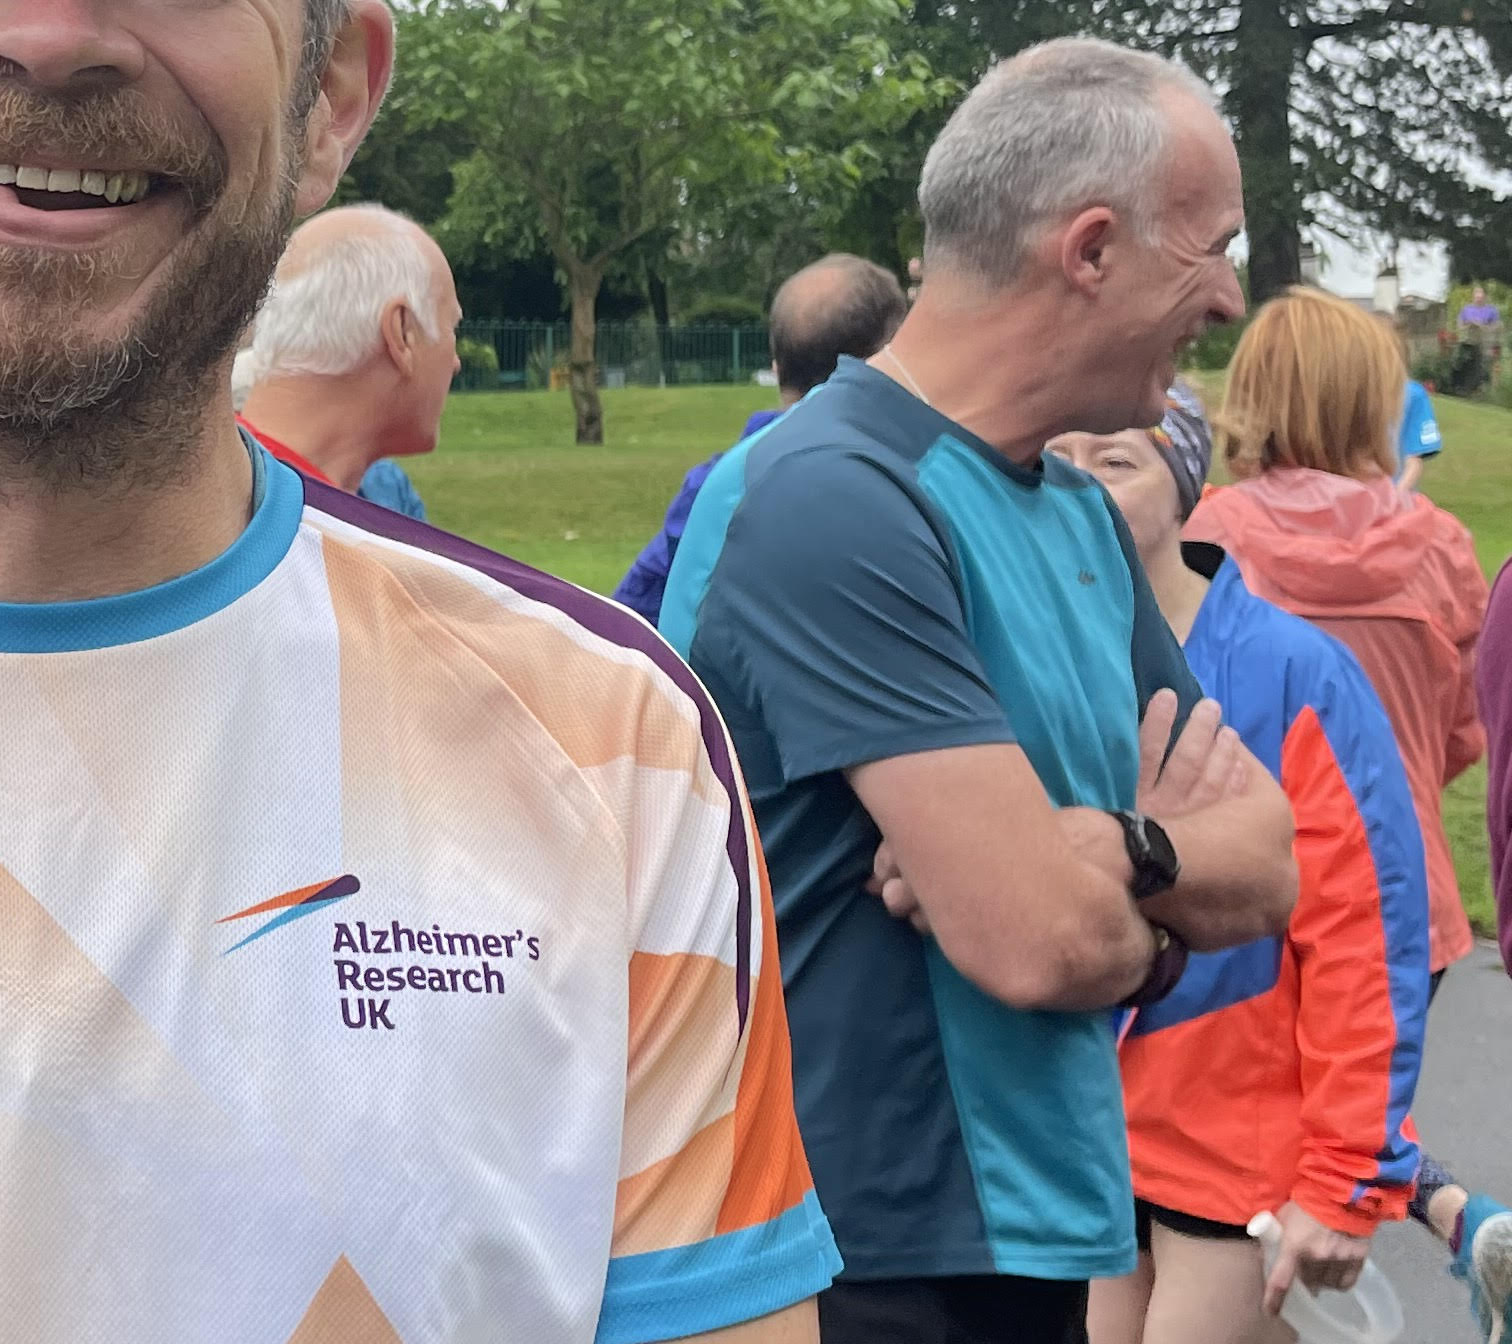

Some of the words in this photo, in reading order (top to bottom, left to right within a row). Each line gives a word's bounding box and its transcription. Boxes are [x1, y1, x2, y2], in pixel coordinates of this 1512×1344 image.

[332, 920, 540, 961] Alzheimer's
[333, 959, 506, 995] Research
[340, 997, 396, 1031] UK
